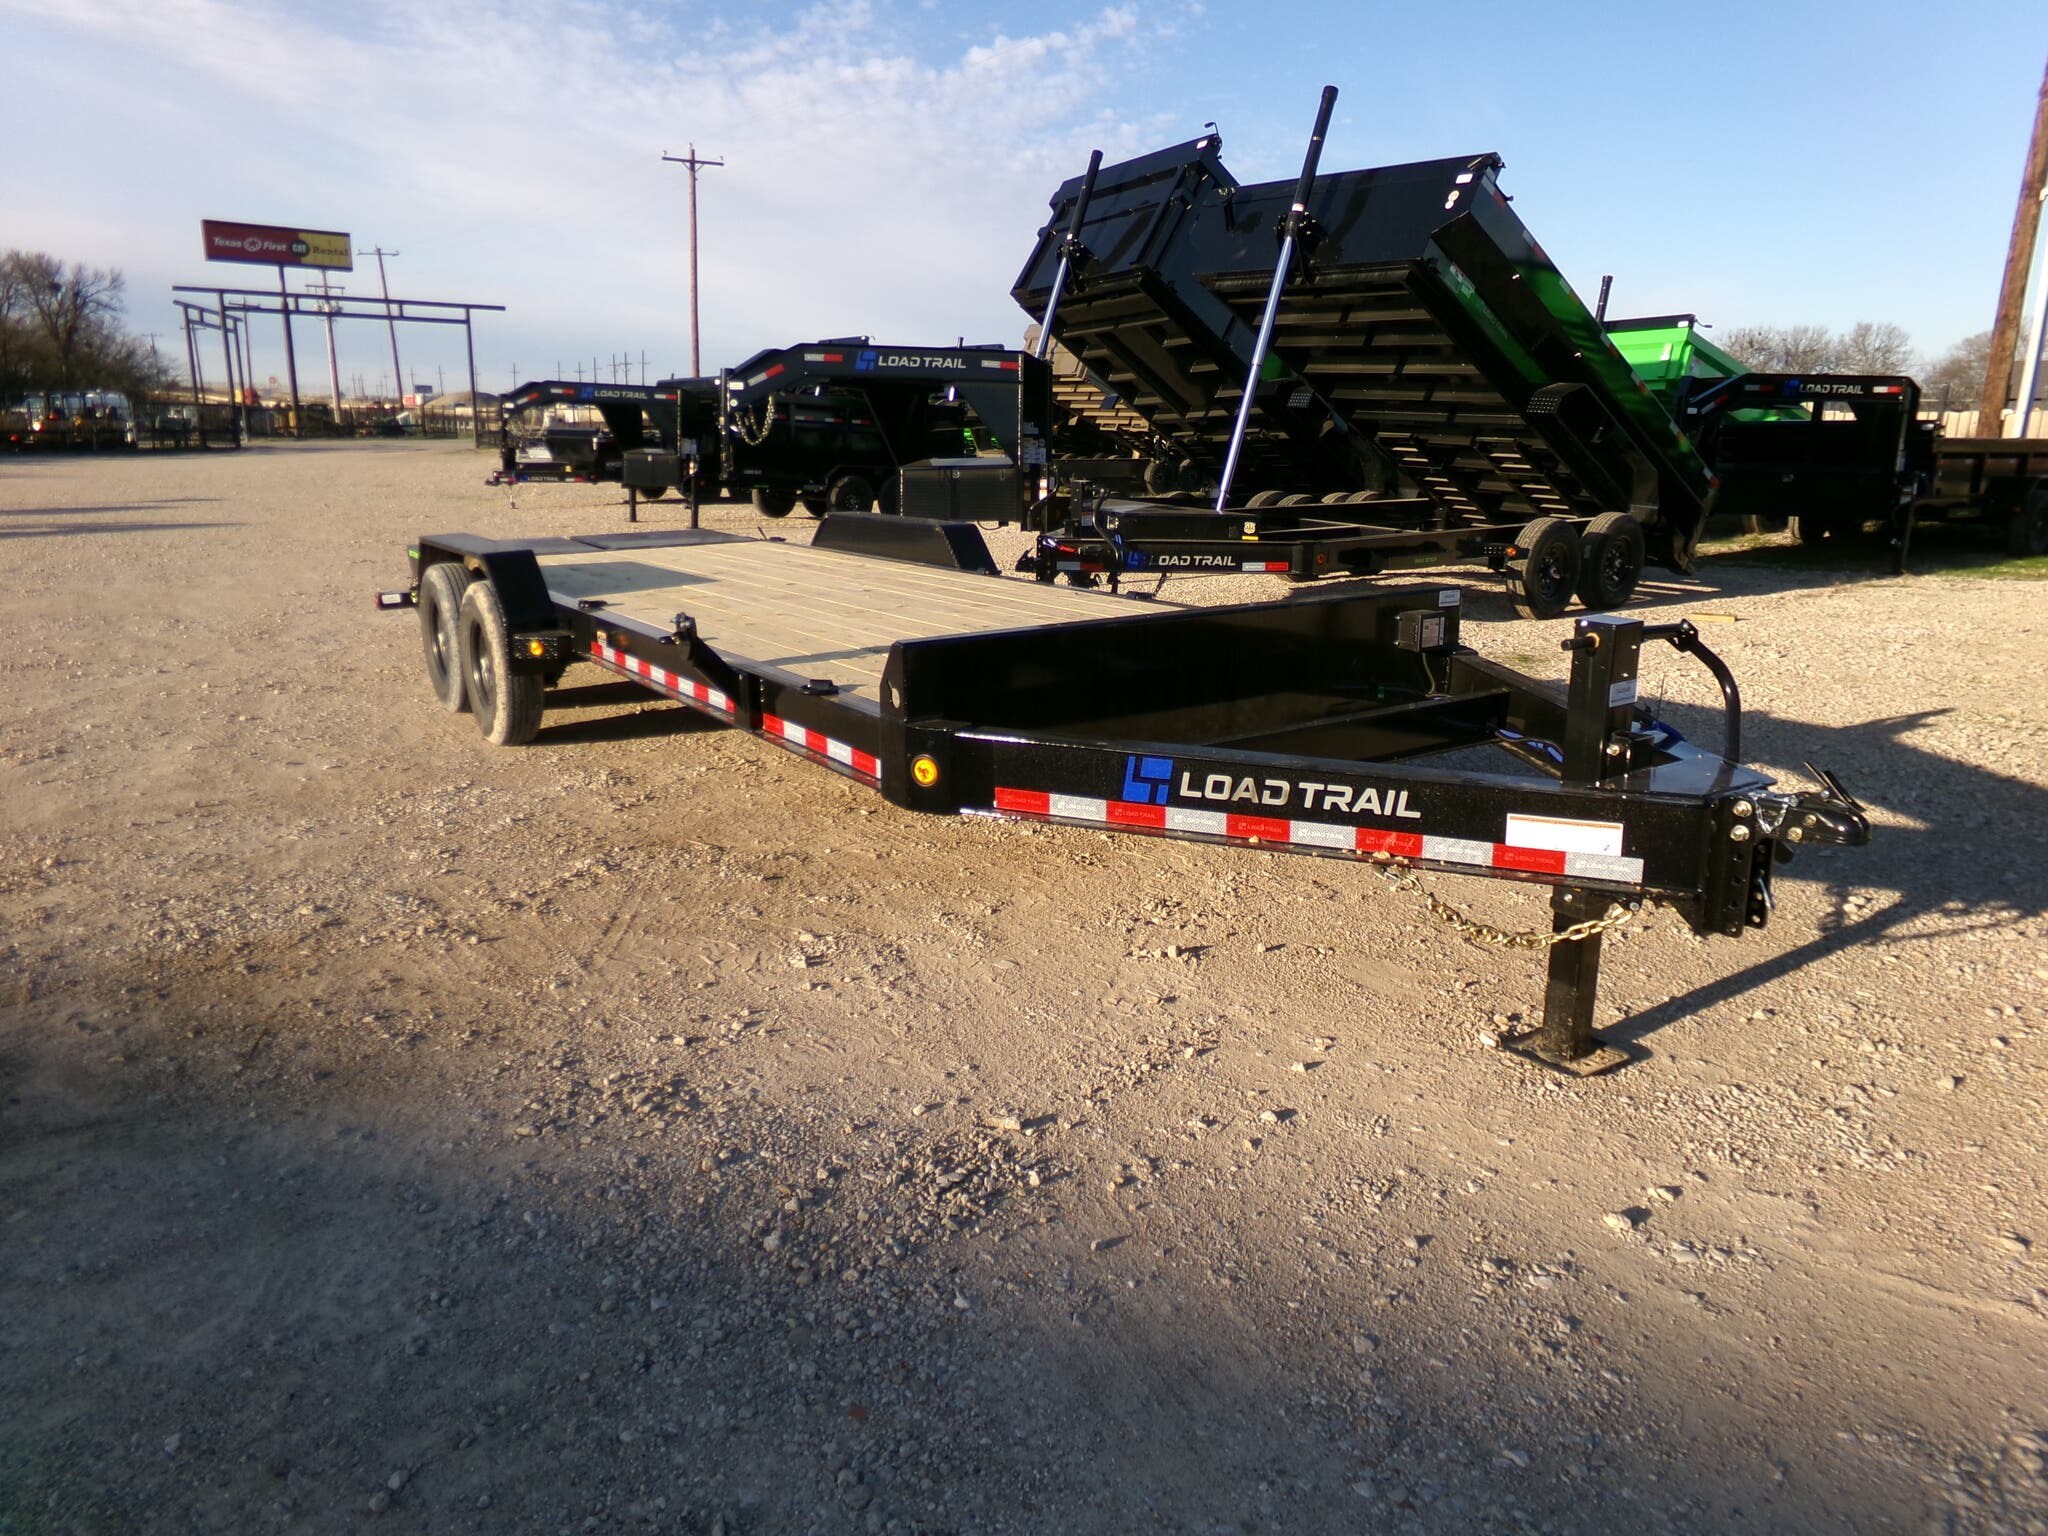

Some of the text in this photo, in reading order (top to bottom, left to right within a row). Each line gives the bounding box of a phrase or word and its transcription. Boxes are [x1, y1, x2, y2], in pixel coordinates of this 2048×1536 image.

[213, 236, 242, 248] Texas
[263, 241, 287, 252] First
[312, 245, 349, 257] Rental
[878, 355, 967, 369] LOAD TRAIL
[594, 389, 648, 400] LOAD TRAIL
[1799, 383, 1864, 395] LOAD TRAIL
[1193, 556, 1236, 566] TRAIL
[1178, 771, 1422, 820] LOAD TRAIL
